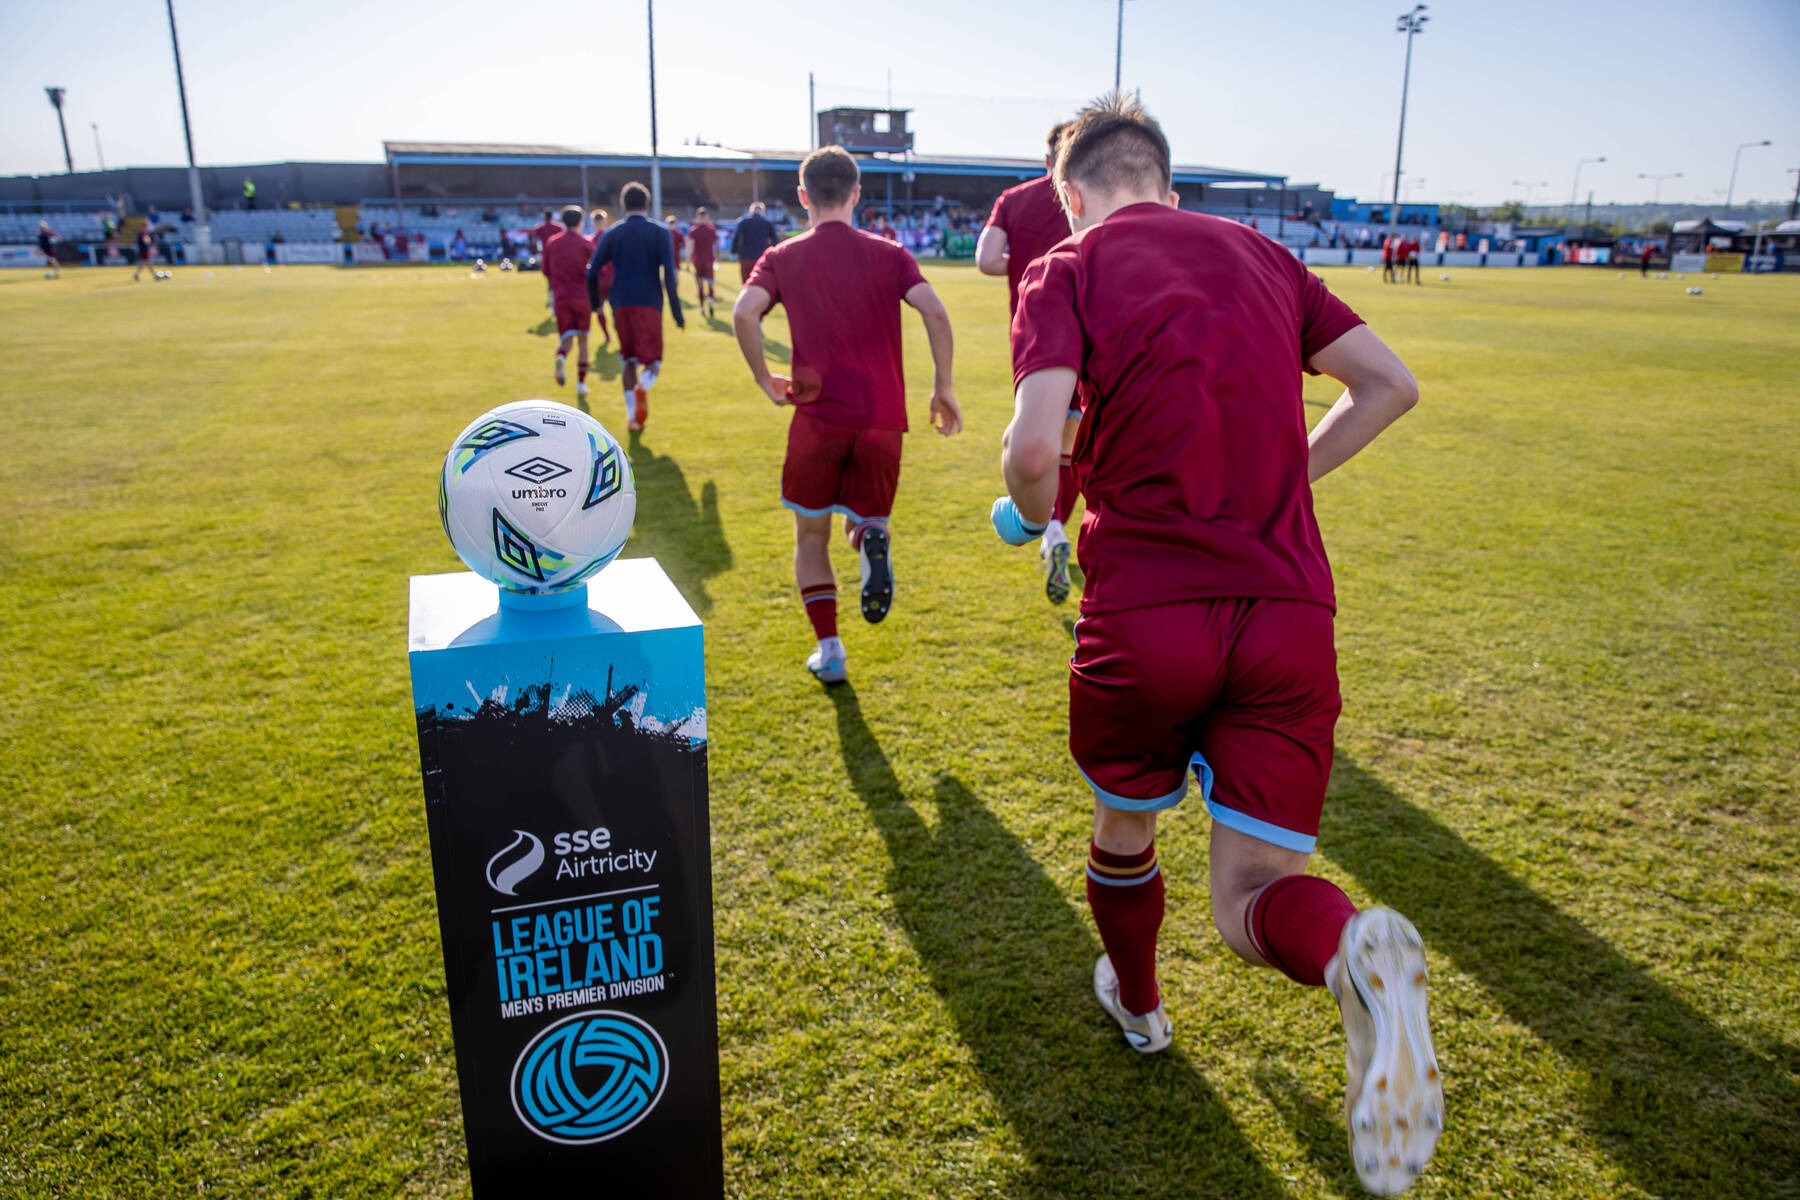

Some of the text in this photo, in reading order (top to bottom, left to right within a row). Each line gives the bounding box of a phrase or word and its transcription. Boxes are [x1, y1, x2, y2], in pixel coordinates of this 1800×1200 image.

[511, 486, 567, 499] umbro
[553, 827, 611, 856] sse
[556, 848, 657, 880] Airtricity
[492, 895, 660, 957] LEAGUE OF
[496, 933, 663, 1002] IRELAND
[501, 974, 665, 1019] MEN'S PREMIER DIVISION
